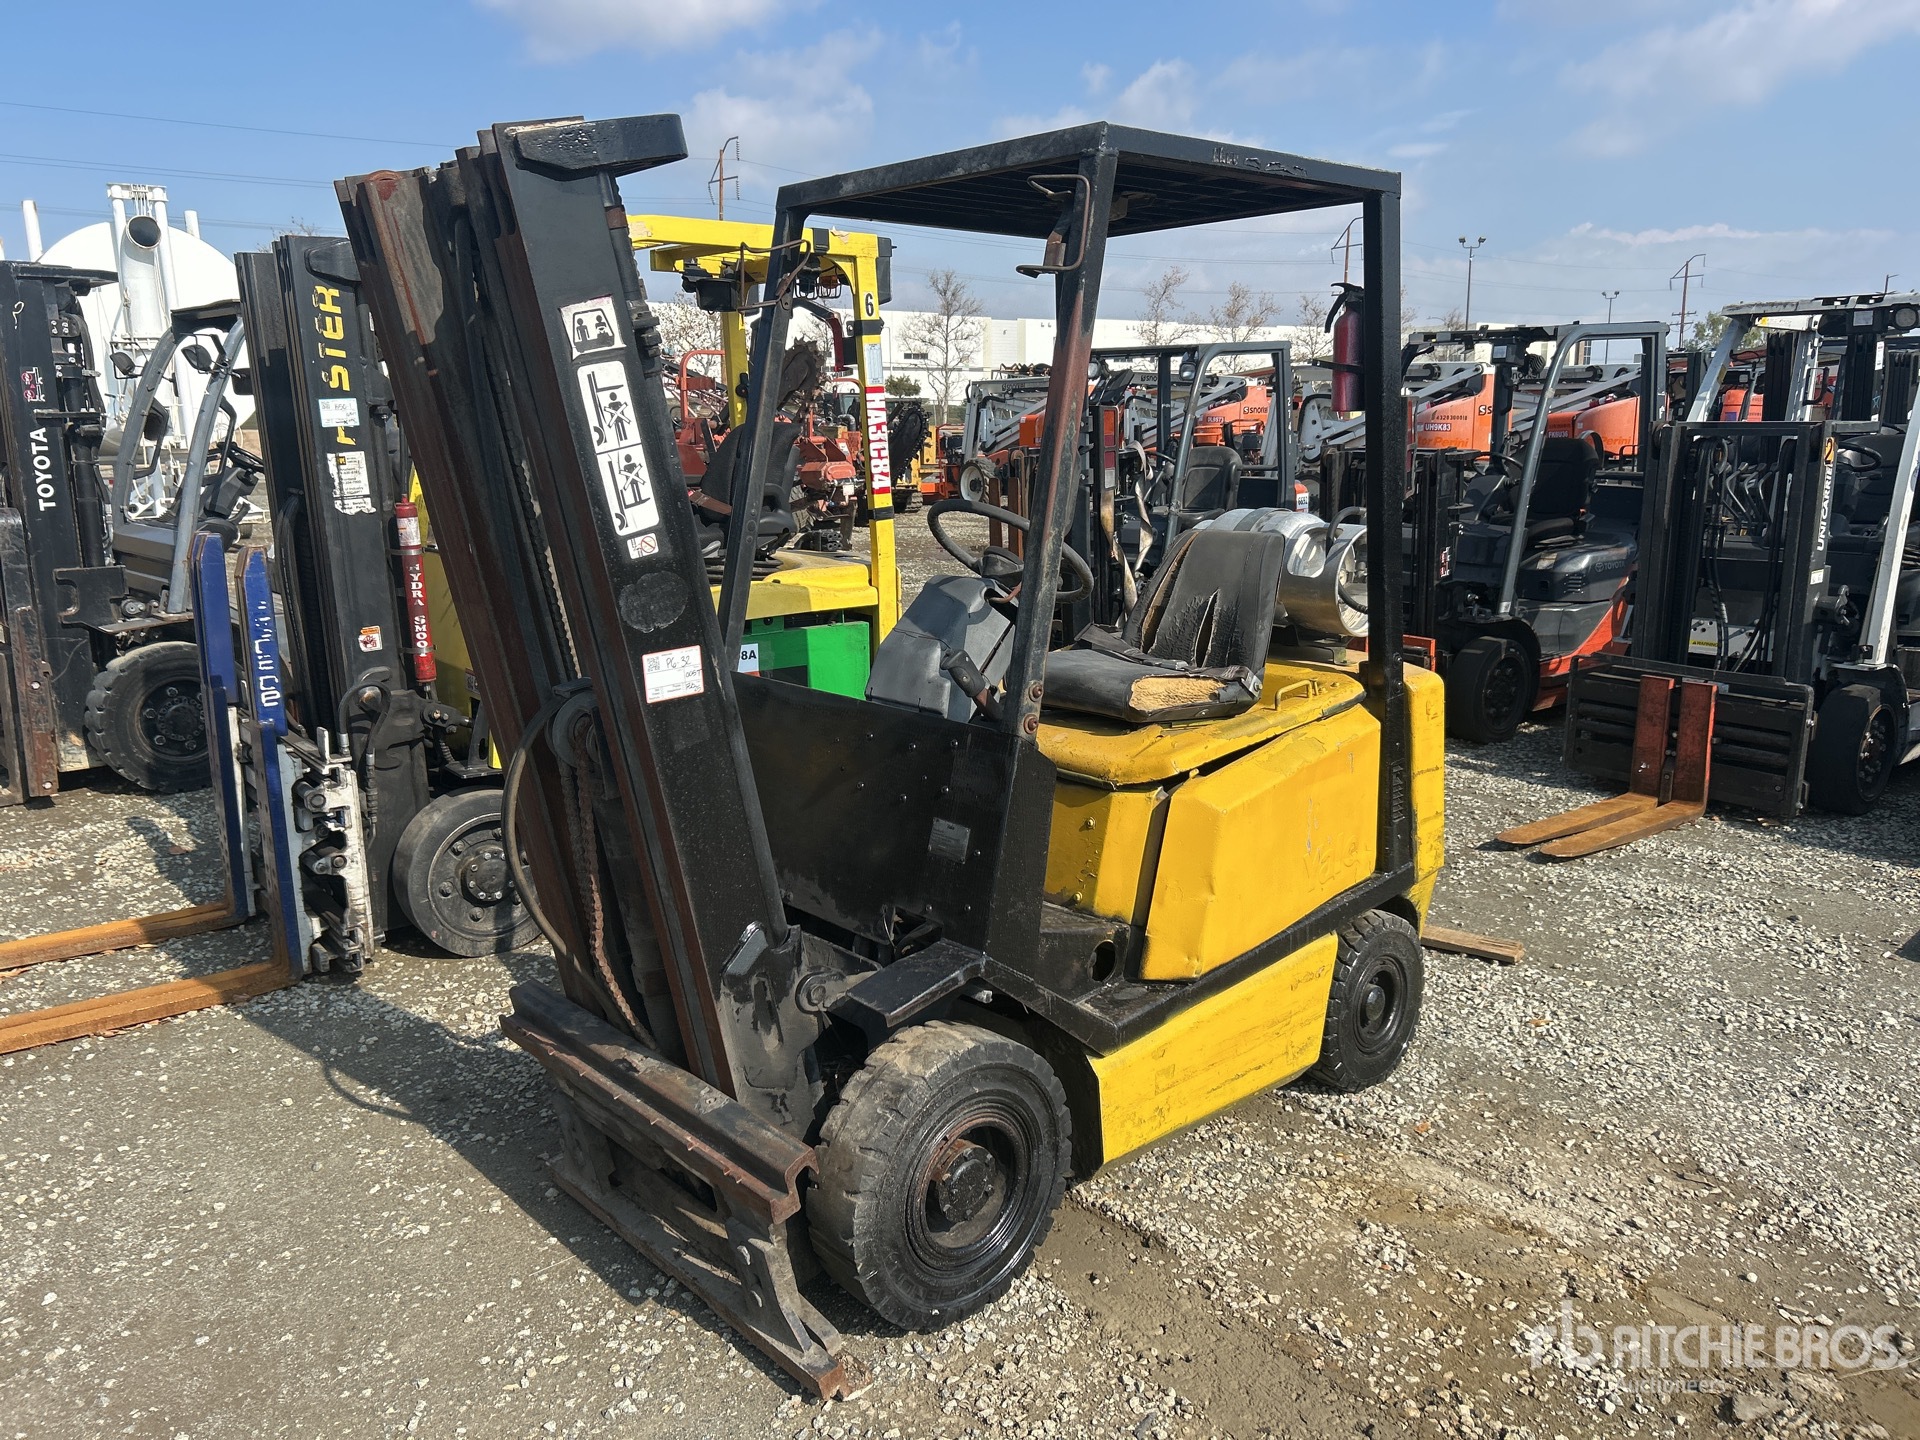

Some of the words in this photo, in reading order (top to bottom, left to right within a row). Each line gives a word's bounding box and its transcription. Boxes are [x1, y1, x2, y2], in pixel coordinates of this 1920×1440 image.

[30, 427, 56, 512] TOYOTA
[866, 392, 891, 489] HA3C84
[1816, 462, 1834, 552] UNICARRIE
